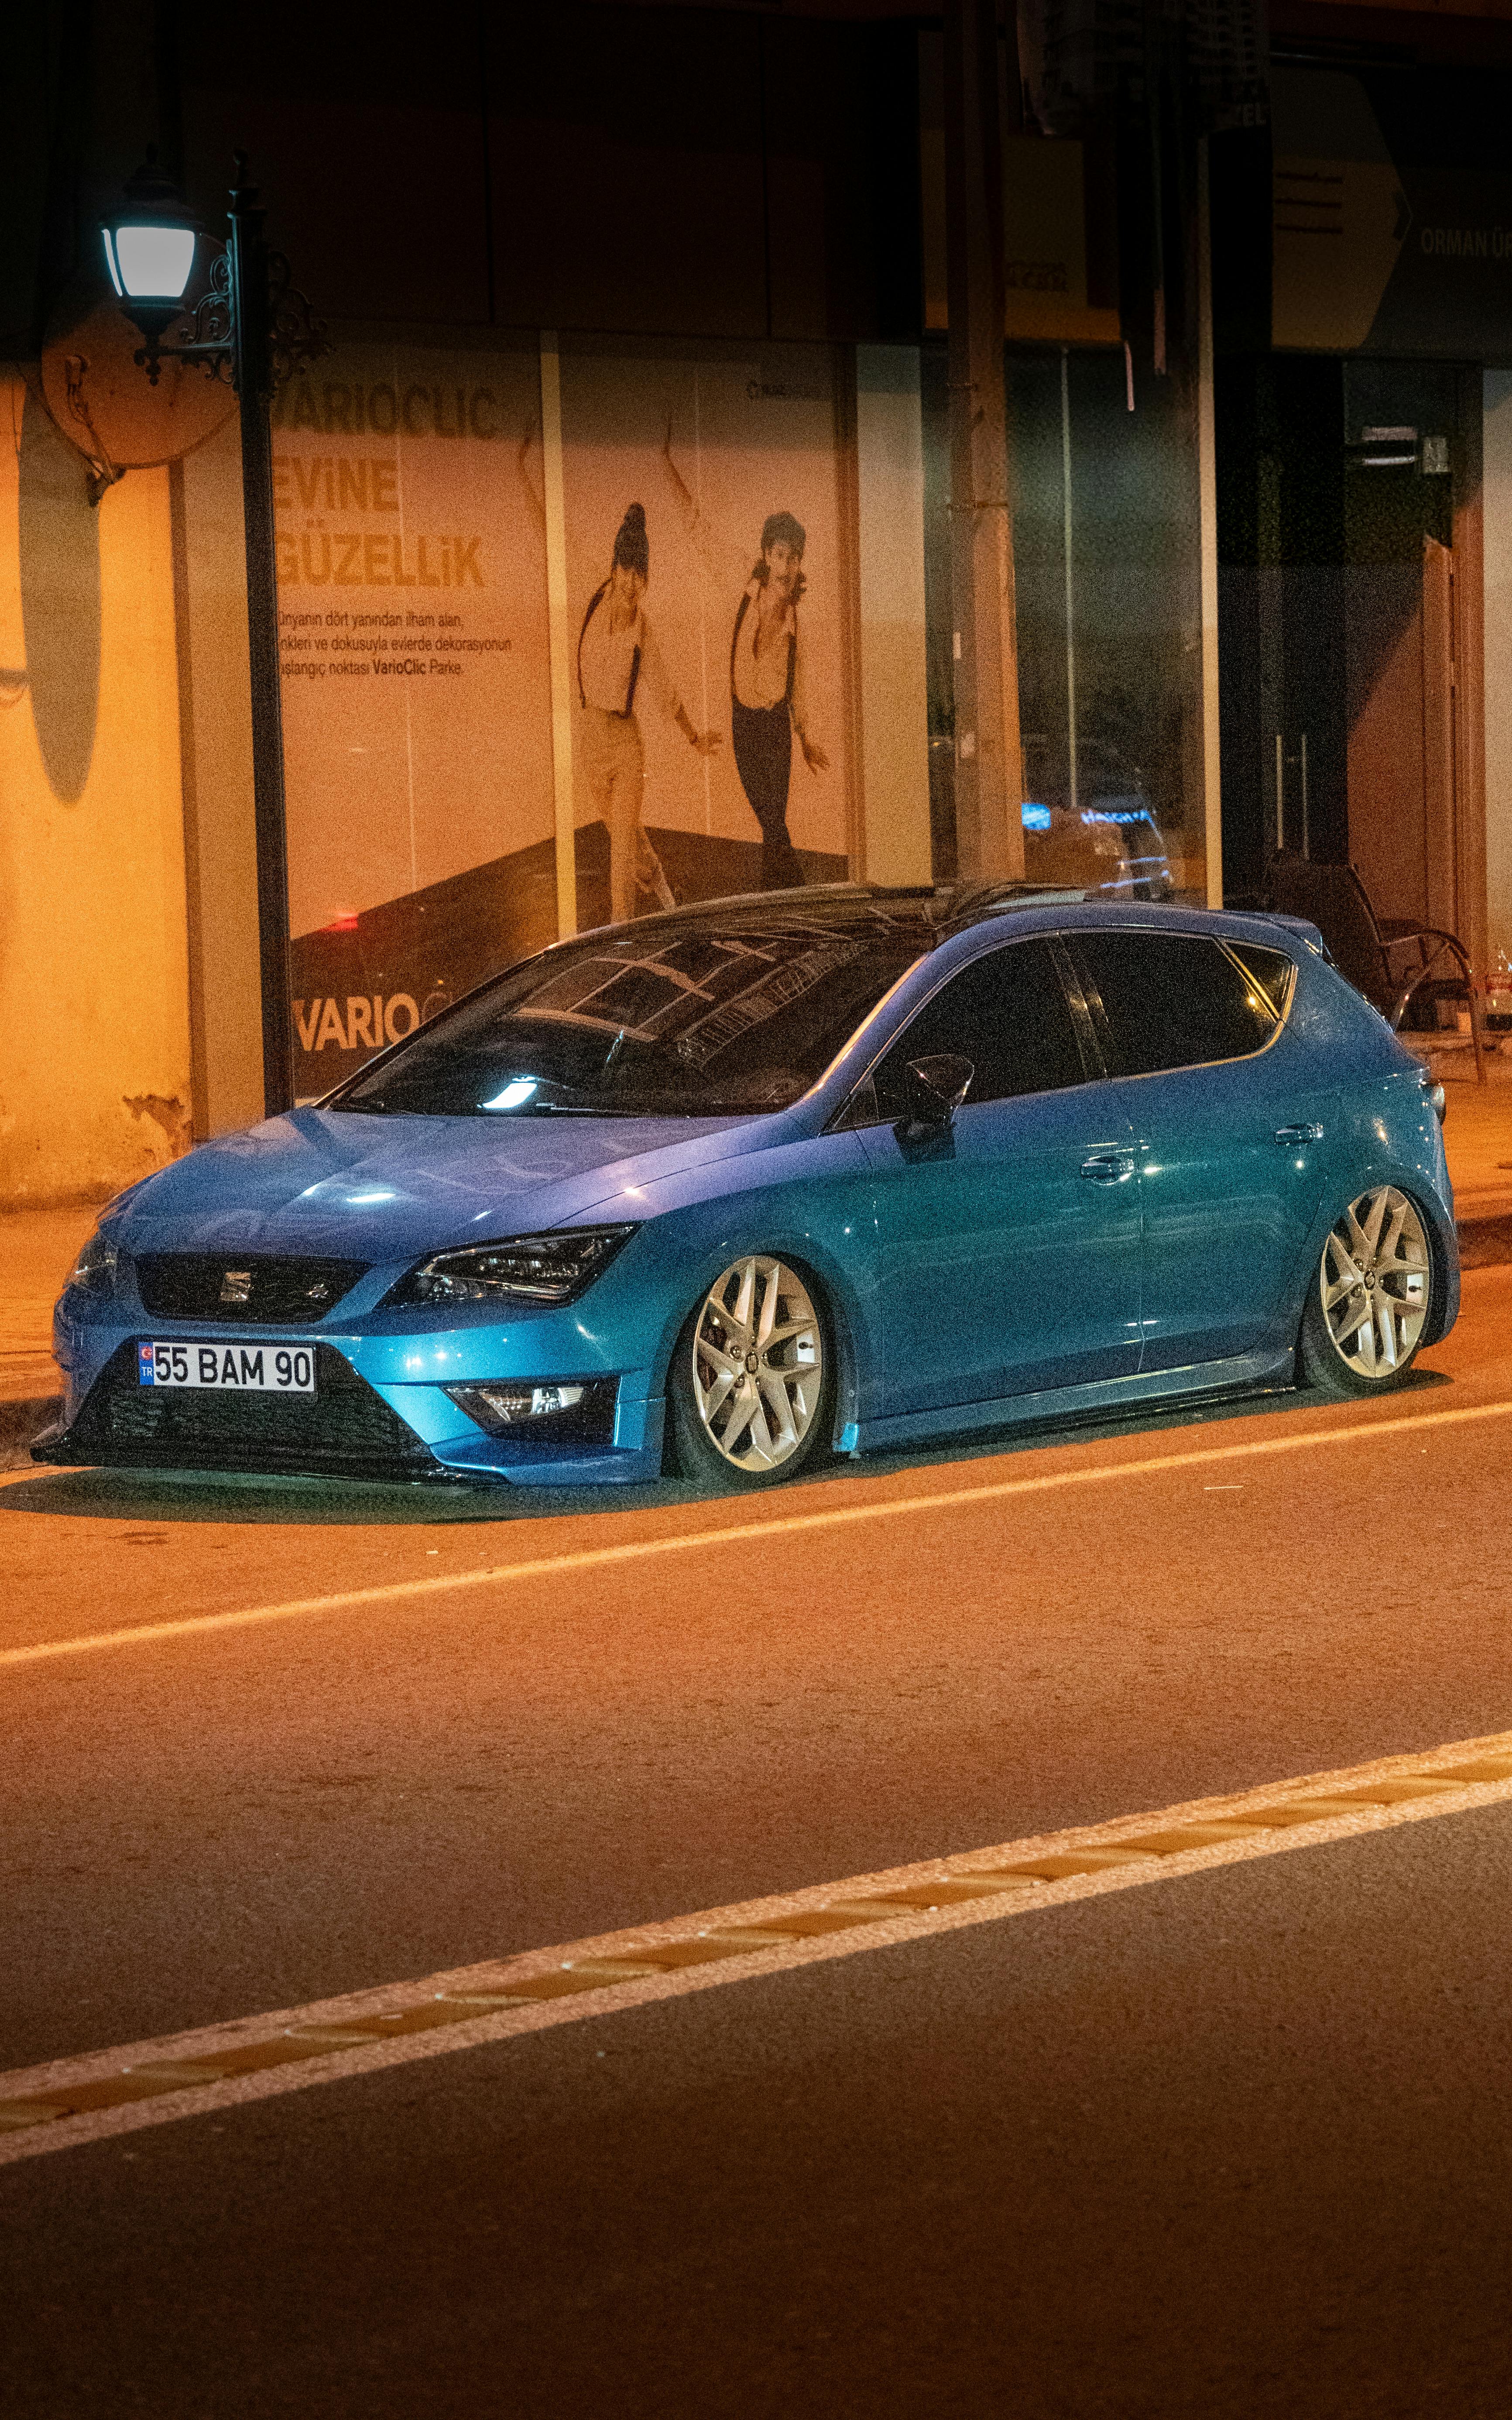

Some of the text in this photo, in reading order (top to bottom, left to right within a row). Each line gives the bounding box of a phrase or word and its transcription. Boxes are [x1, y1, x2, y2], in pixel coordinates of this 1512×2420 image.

[1421, 227, 1487, 257] ORMAN
[278, 611, 322, 631] ünyanın
[325, 610, 349, 626] dört
[352, 611, 403, 631] yanından
[315, 638, 328, 650] ve
[331, 634, 387, 655] dokusuyla
[392, 635, 432, 651] evlerde
[435, 635, 511, 655] dekorasyonun
[329, 659, 369, 675] noktası
[373, 659, 425, 675] VarioClic
[291, 993, 420, 1051] VARIO
[142, 1366, 153, 1377] TR
[154, 1346, 311, 1387] 55 BAM 90
